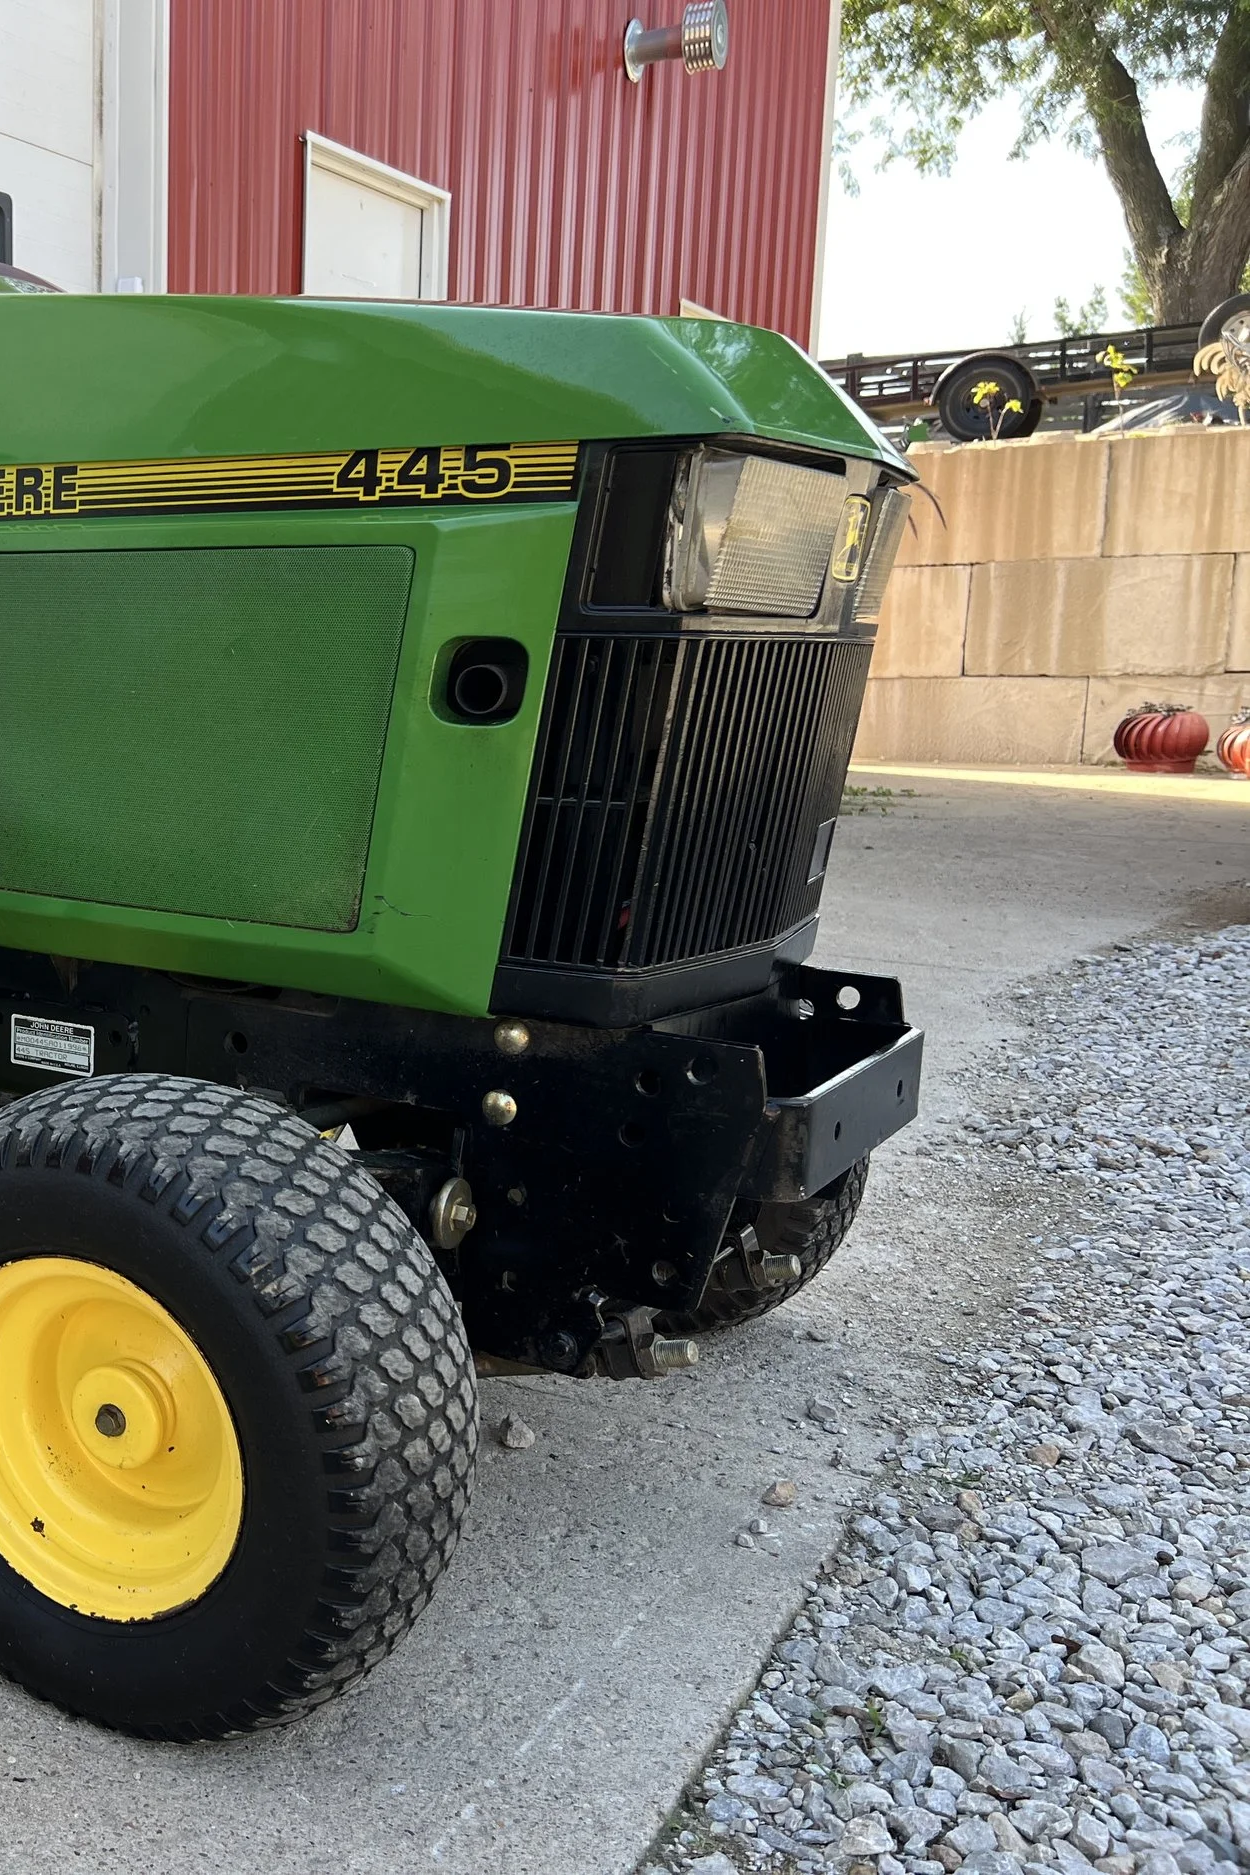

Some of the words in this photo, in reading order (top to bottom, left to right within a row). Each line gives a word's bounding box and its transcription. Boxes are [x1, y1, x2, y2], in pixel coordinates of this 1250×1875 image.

[333, 443, 514, 500] 445
[30, 1022, 49, 1031] JOHN
[51, 1025, 74, 1034] DEERE
[35, 1049, 68, 1060] TRACTOR
